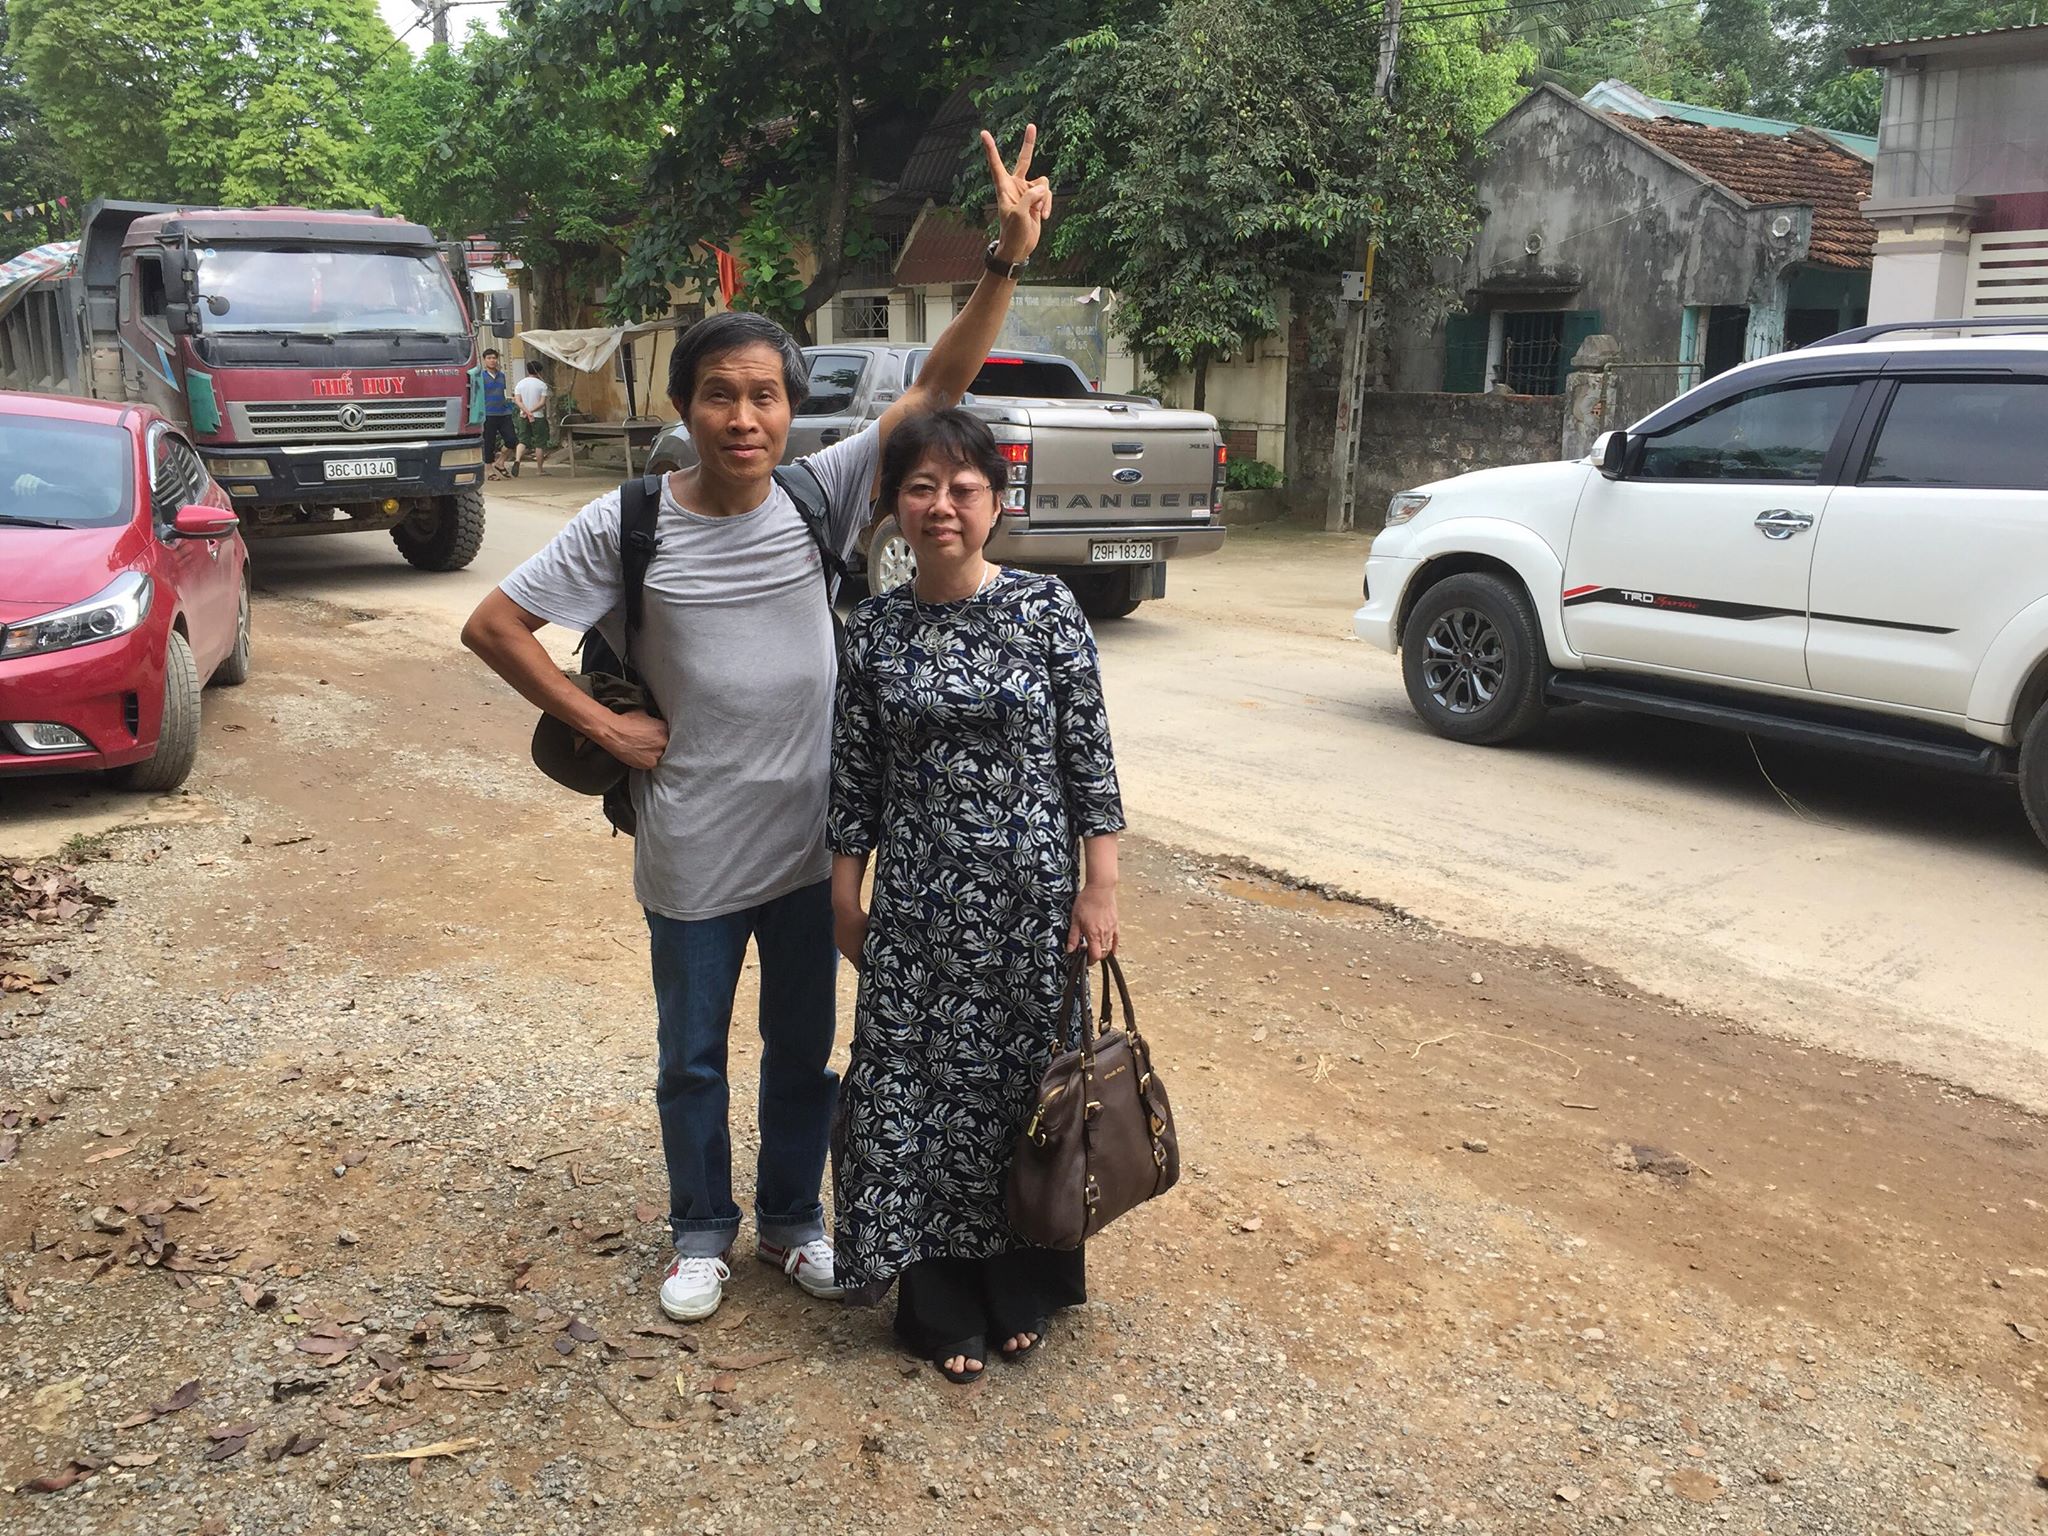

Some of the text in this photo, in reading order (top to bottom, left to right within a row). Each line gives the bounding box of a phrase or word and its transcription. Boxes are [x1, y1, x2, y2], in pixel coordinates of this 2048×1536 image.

[361, 376, 406, 394] HUY
[327, 461, 394, 478] 36C-013.40
[1036, 493, 1208, 509] RANGER
[1094, 543, 1152, 560] 29H-183.28
[1620, 590, 1654, 603] TRD
